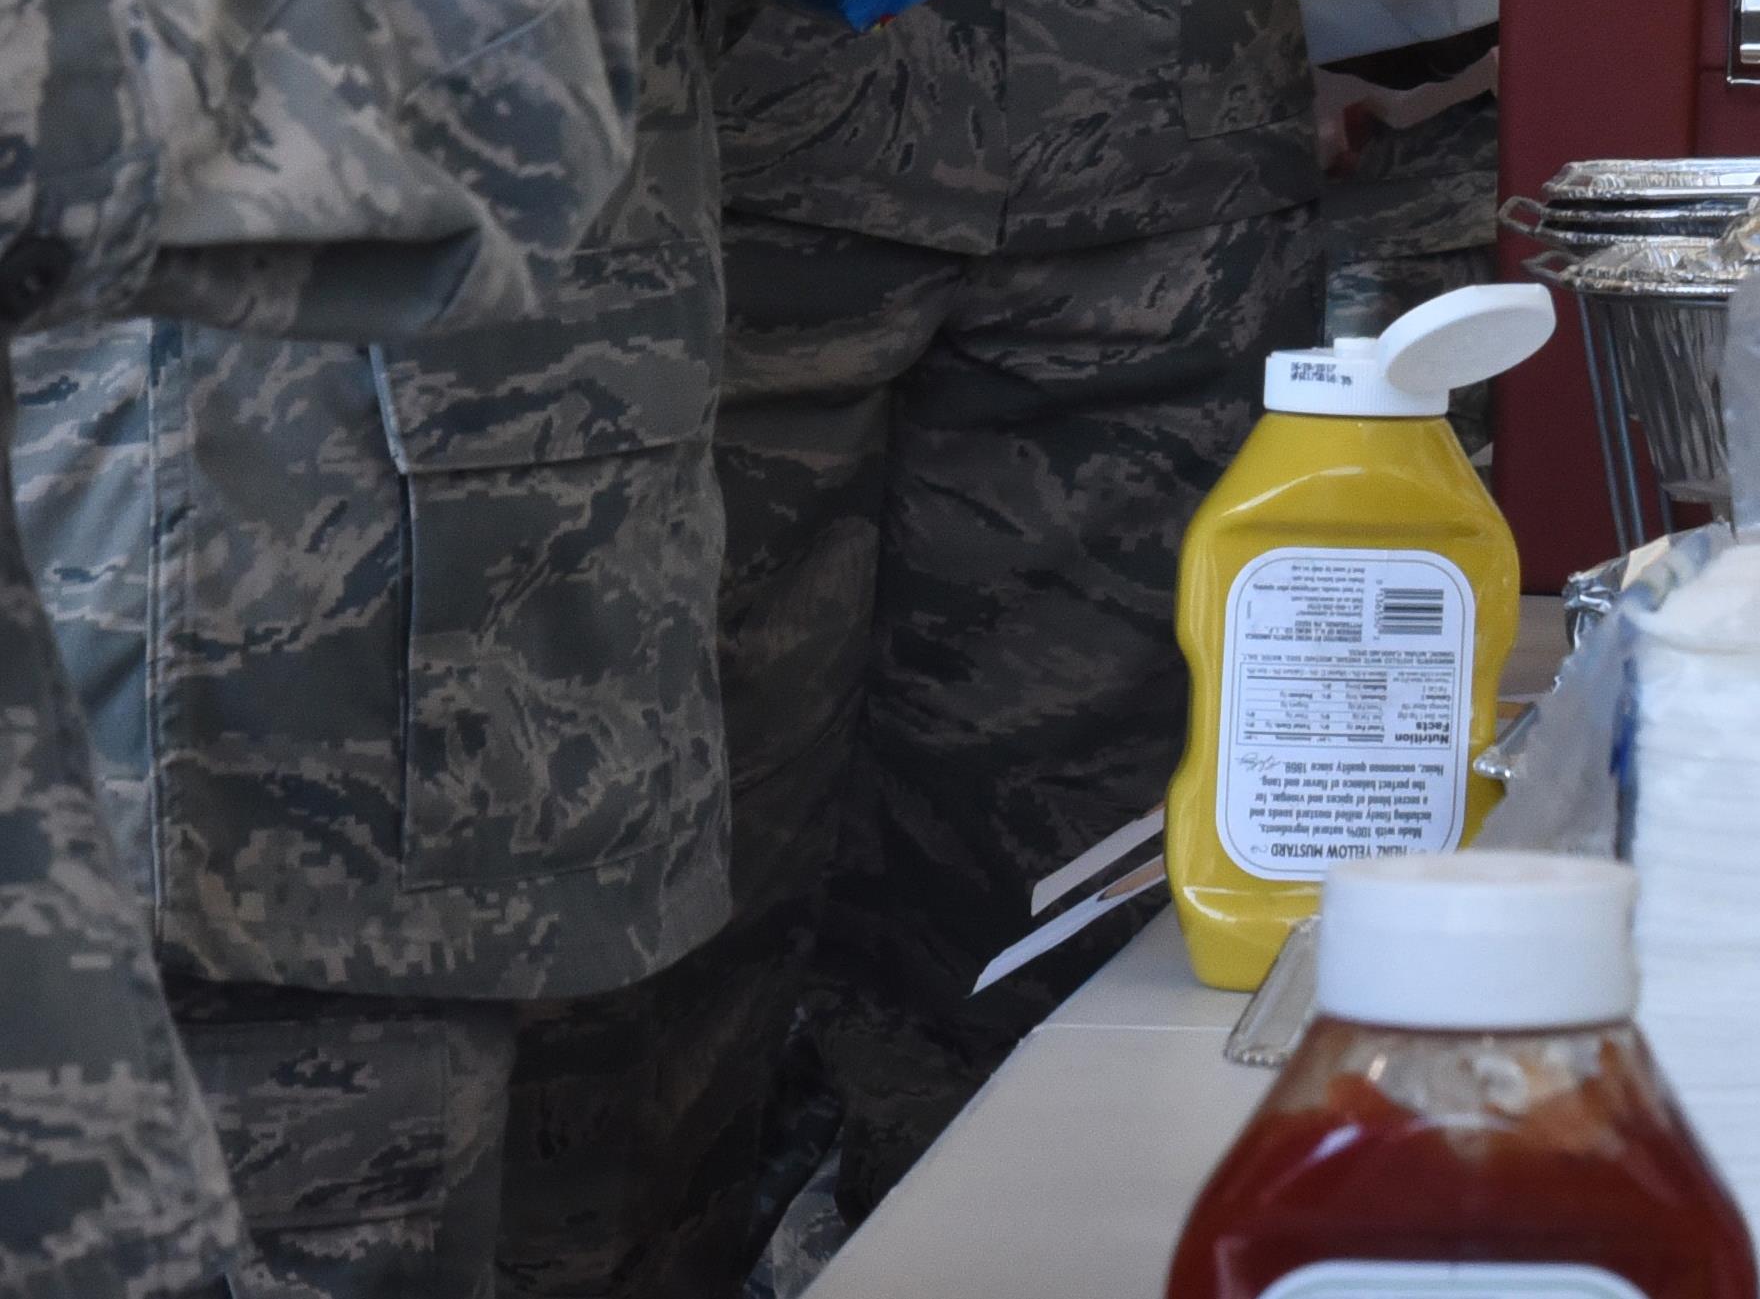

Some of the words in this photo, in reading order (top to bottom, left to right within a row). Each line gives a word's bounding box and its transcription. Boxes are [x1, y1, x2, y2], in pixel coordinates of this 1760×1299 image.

[1416, 722, 1450, 732] Facts
[1395, 733, 1450, 745] Nutrition
[1336, 761, 1367, 775] quality
[1331, 779, 1339, 790] of
[1378, 778, 1409, 791] perfect
[1356, 796, 1365, 807] of
[1296, 809, 1332, 821] mustard
[1366, 808, 1391, 823] finely
[1346, 827, 1371, 838] 100%
[1271, 843, 1323, 858] MUSTARD
[1327, 845, 1371, 859] YELLOW
